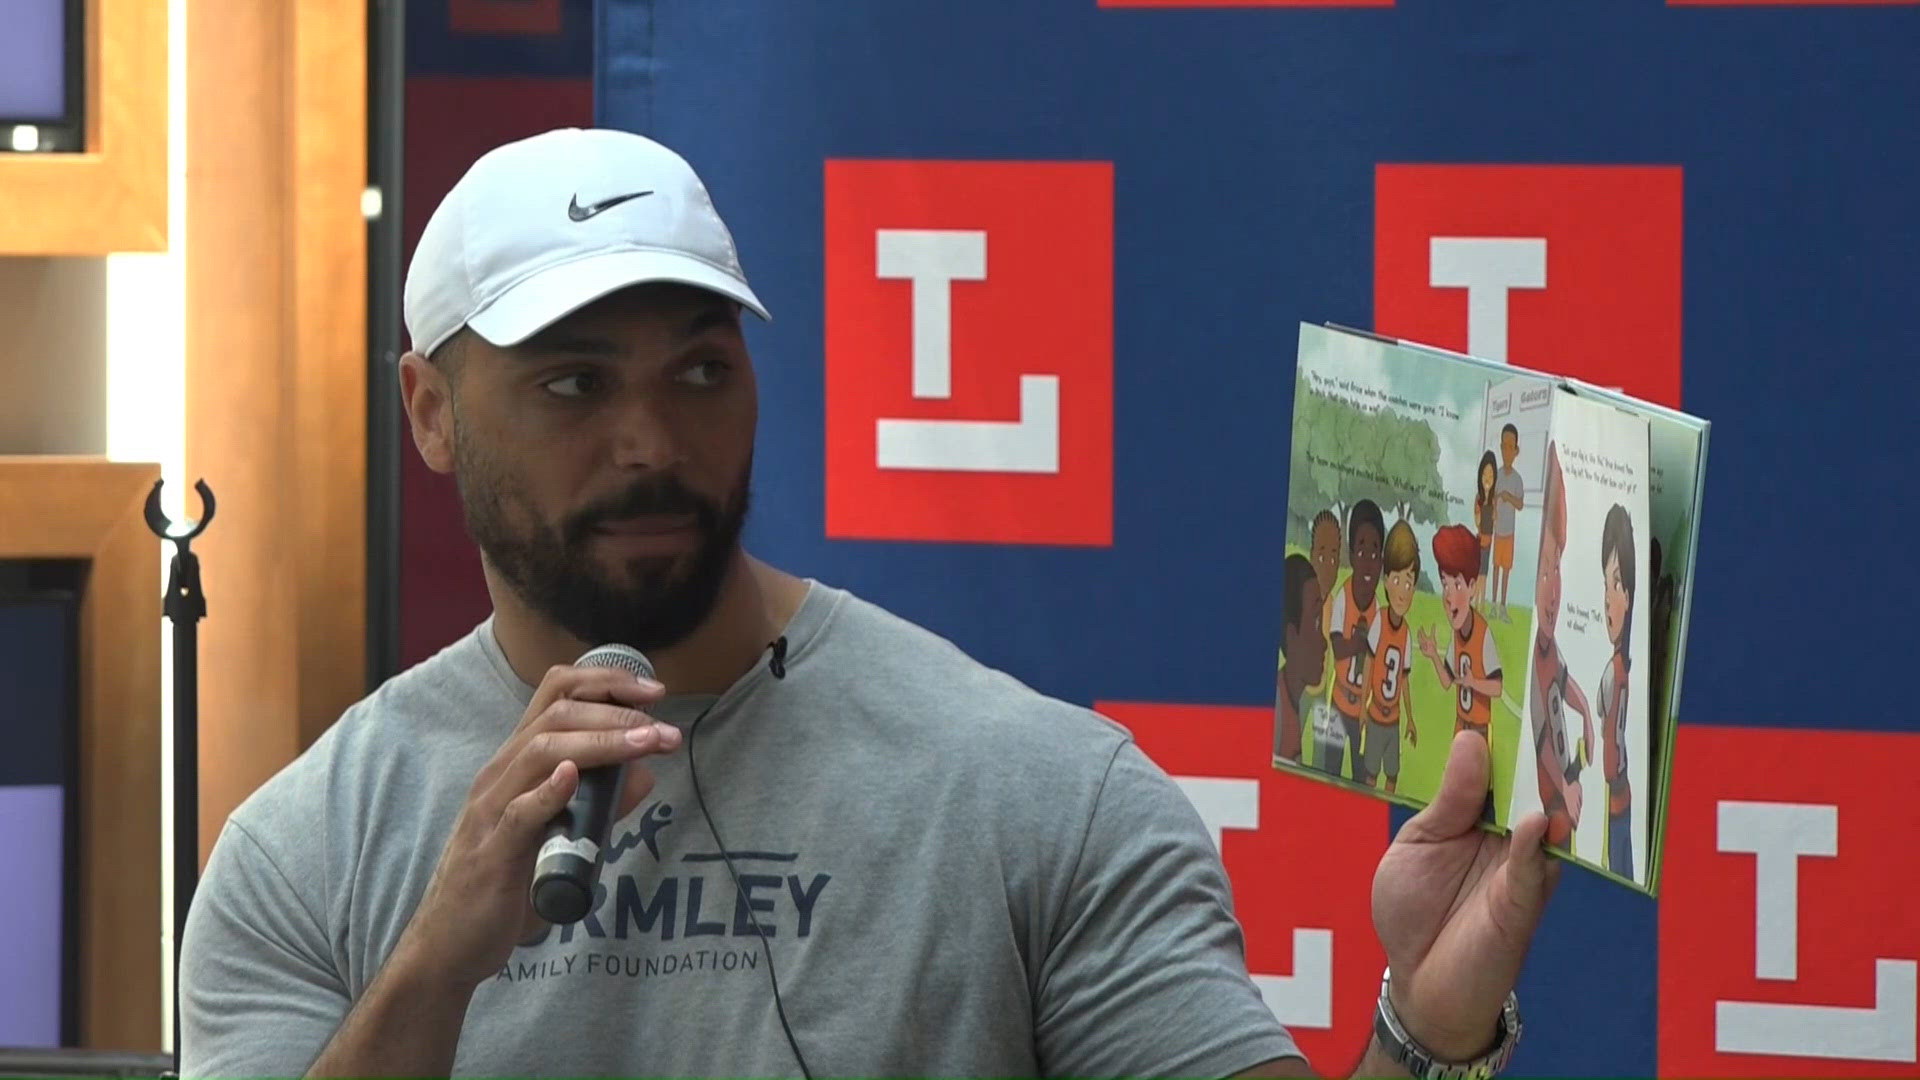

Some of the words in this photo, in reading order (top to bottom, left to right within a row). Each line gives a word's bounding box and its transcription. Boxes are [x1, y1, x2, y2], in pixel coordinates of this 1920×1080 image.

[1382, 645, 1401, 700] 3
[515, 873, 832, 947] RMLEY
[587, 950, 758, 978] FOUNDATION
